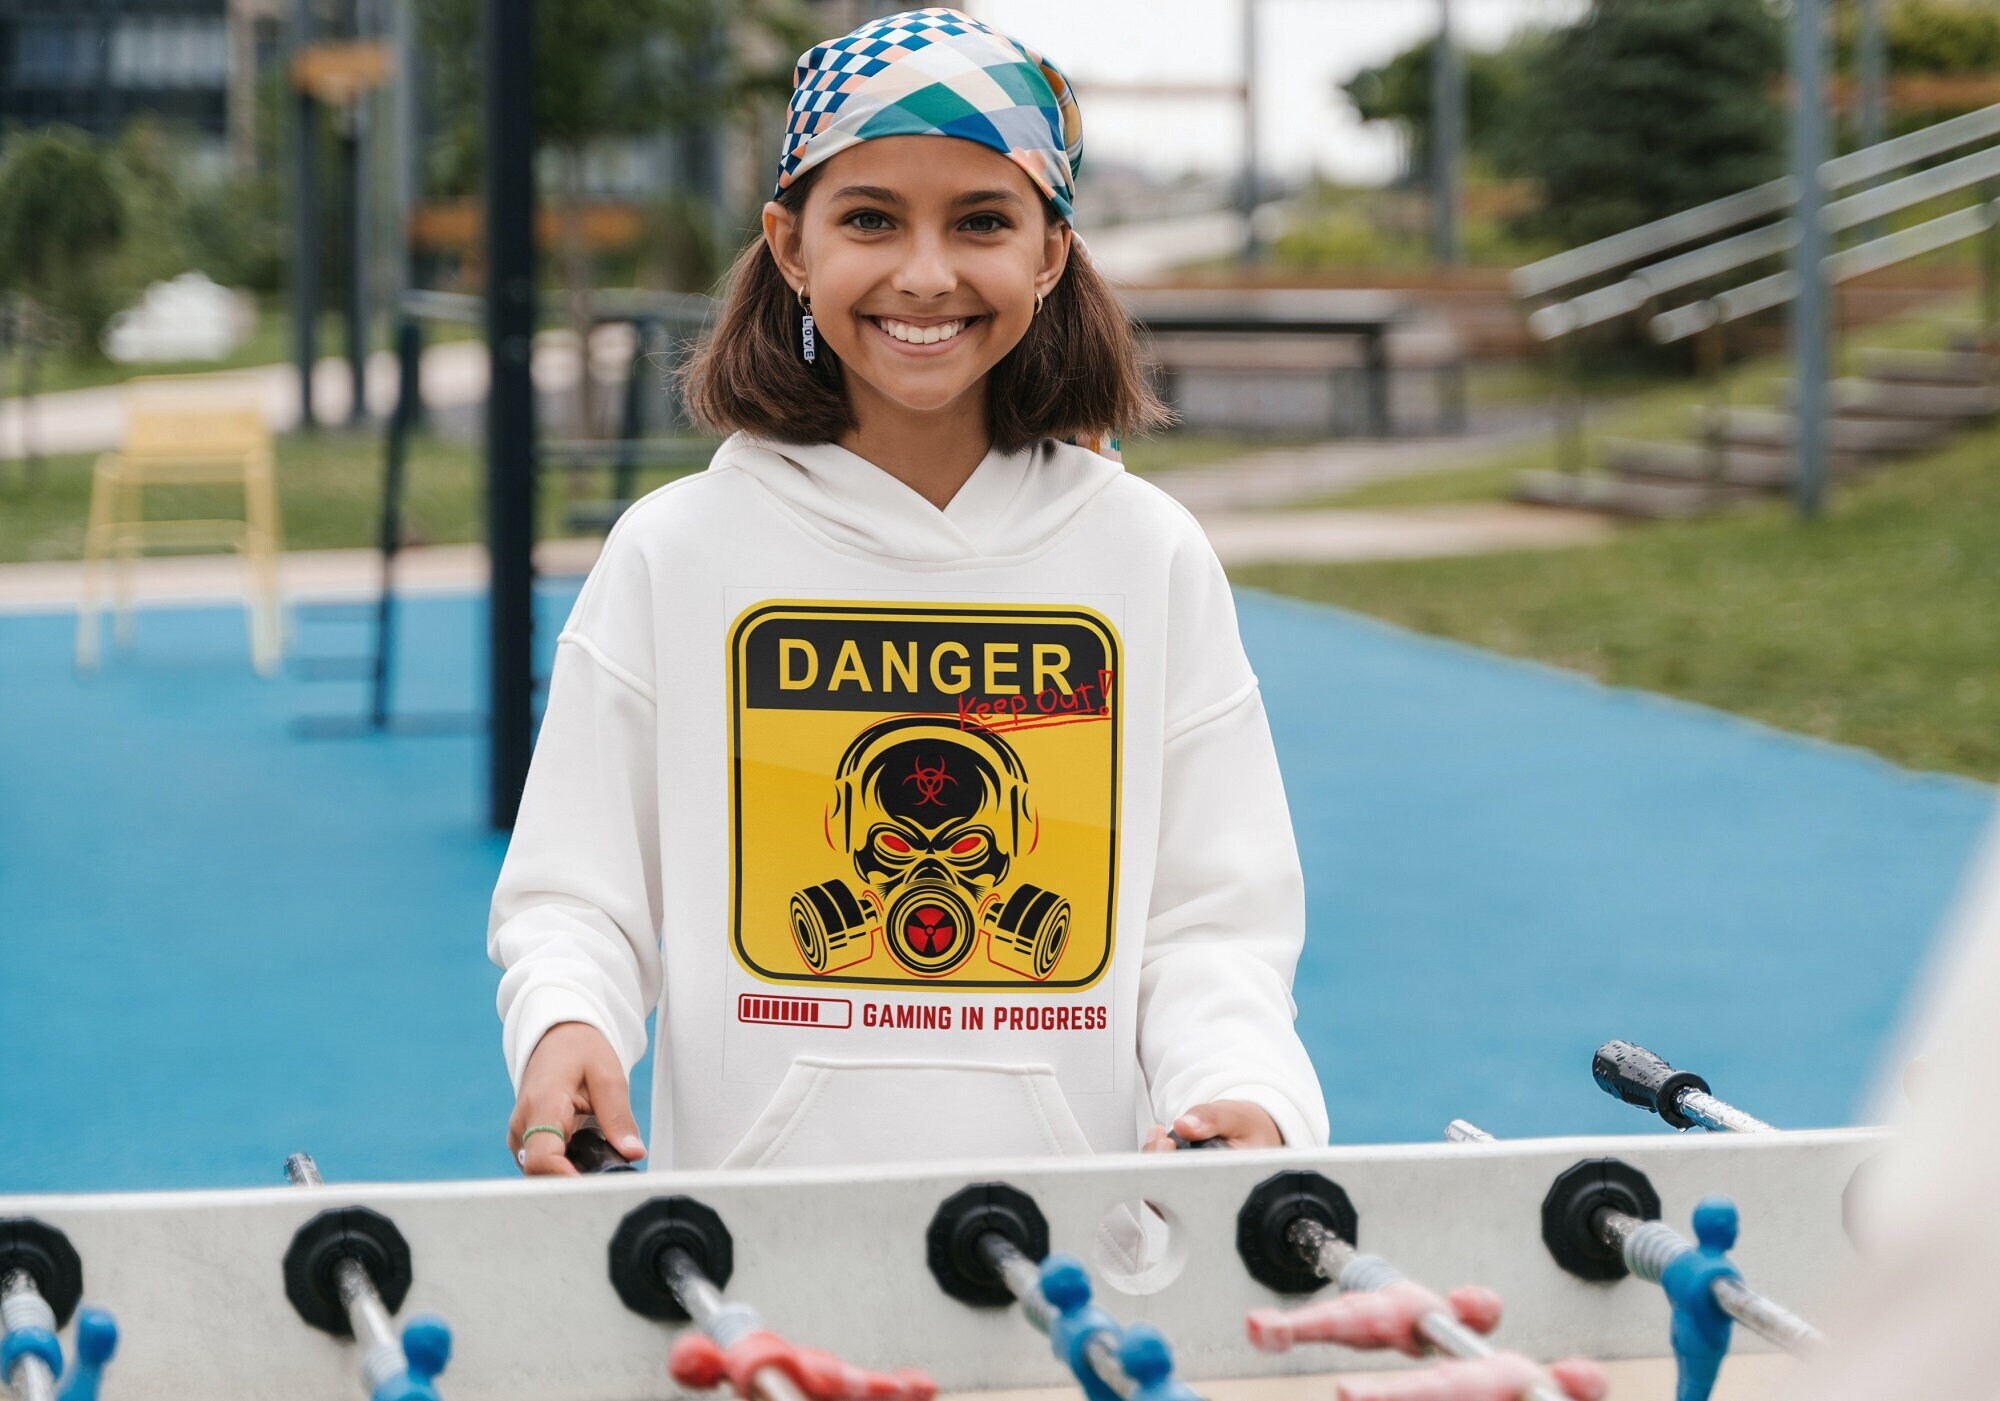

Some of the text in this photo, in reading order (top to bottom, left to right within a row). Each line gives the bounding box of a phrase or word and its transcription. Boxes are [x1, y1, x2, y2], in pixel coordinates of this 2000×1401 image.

[804, 318, 814, 358] LOVE
[778, 638, 1074, 695] DANGER
[957, 694, 1028, 731] Keep
[863, 1003, 1107, 1031] GAMING IN PROGRESS
